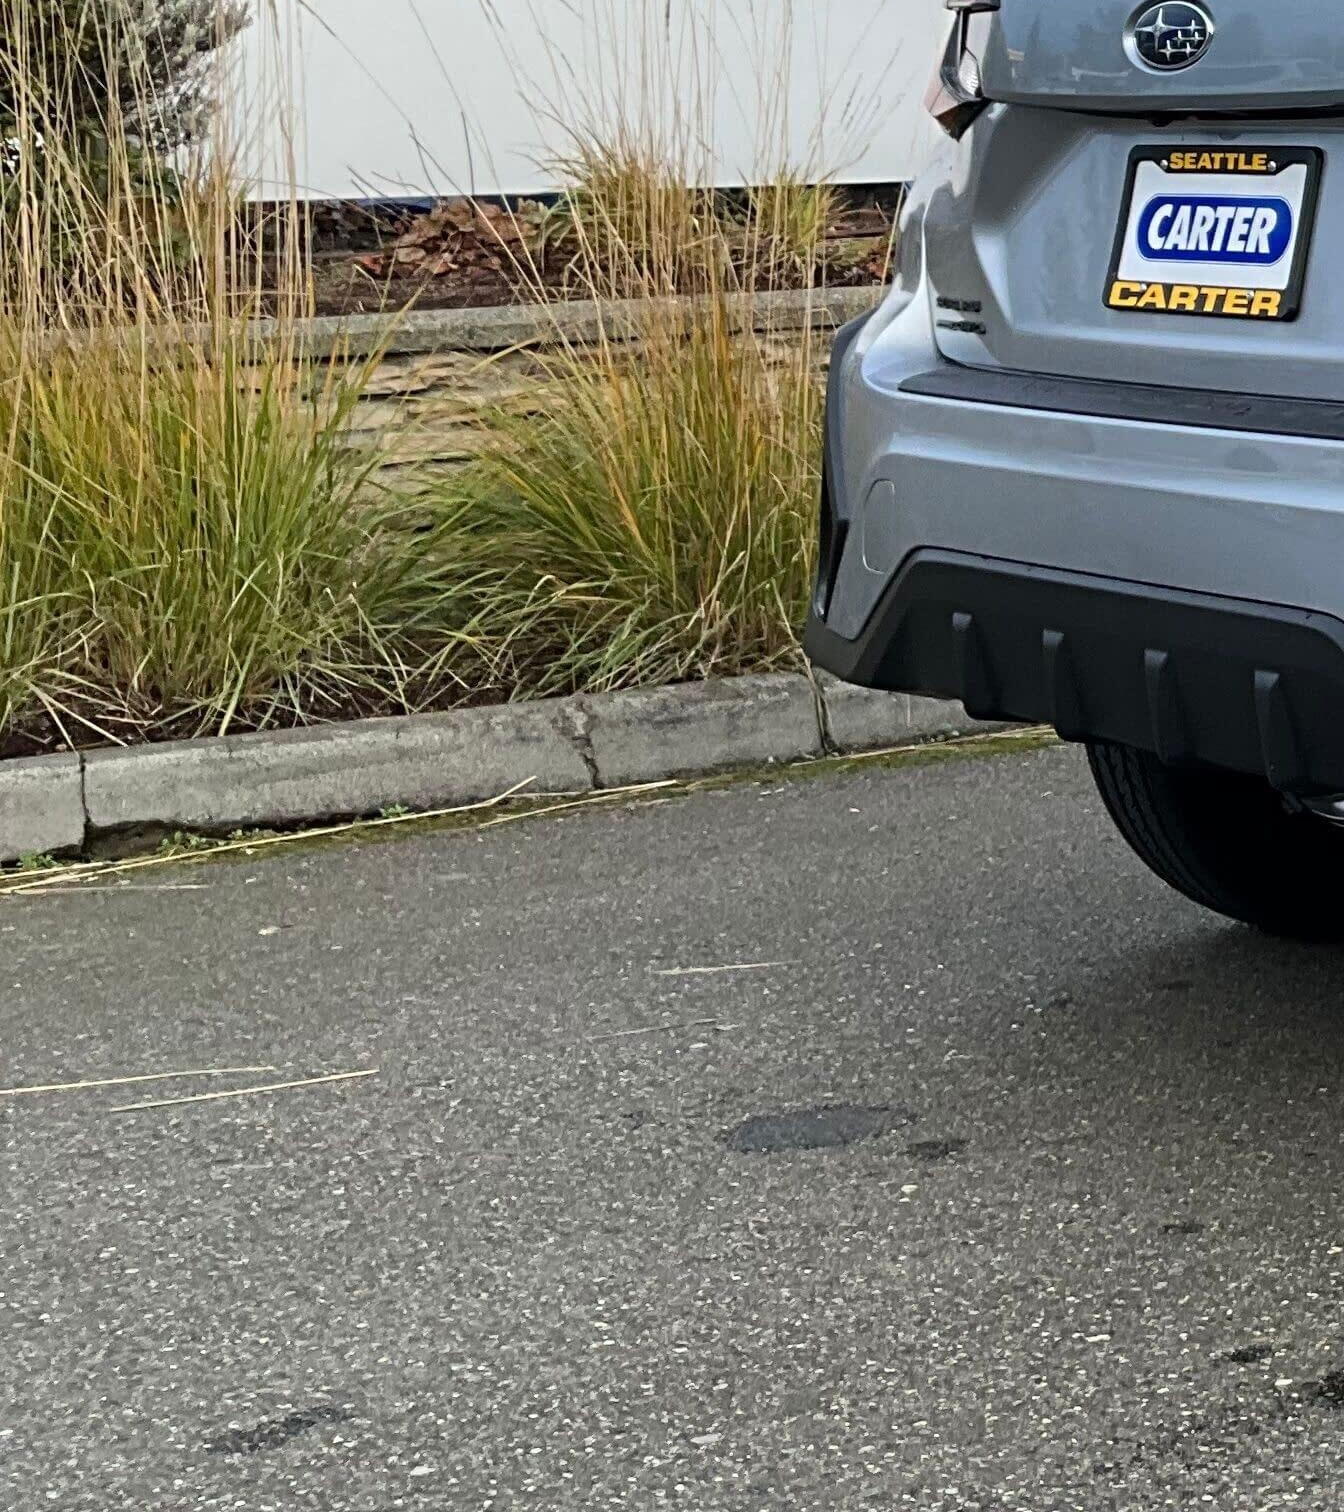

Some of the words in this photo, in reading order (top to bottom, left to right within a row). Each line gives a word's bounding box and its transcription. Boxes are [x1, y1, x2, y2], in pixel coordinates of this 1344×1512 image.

[1169, 152, 1268, 171] SEATTLE
[1147, 203, 1278, 254] CARTER
[1108, 280, 1282, 316] CARTER
